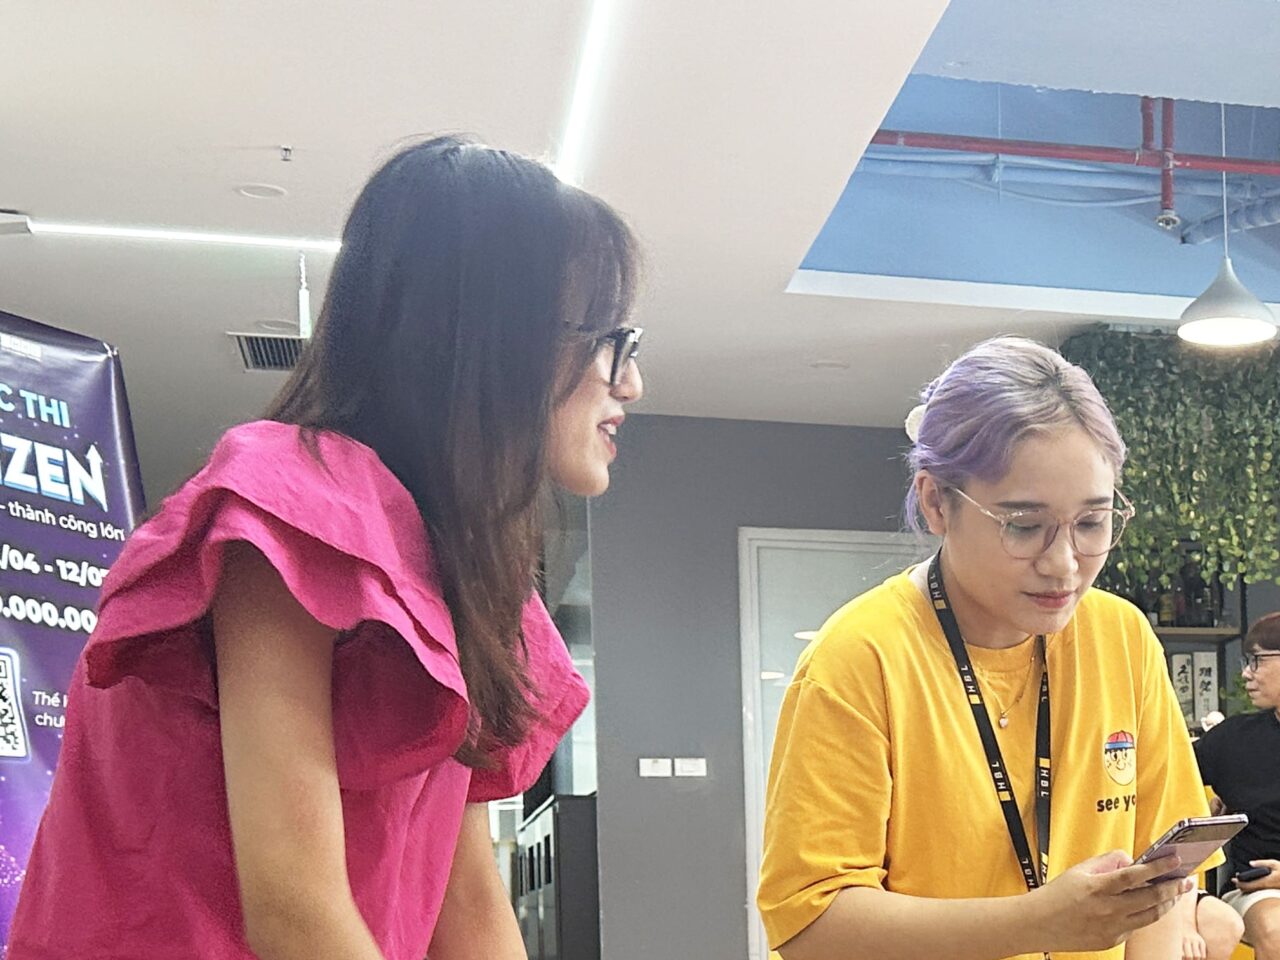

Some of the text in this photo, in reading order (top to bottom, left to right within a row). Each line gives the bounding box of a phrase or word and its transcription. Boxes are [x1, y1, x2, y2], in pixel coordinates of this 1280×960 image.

[19, 388, 71, 429] THI
[0, 431, 109, 513] ZEN
[8, 501, 56, 526] thành
[59, 514, 98, 539] công
[0, 543, 41, 575] /04
[0, 594, 99, 635] .000.00
[960, 664, 977, 693] HBL
[991, 760, 1007, 791] HBL
[1040, 768, 1051, 798] HBL
[1096, 795, 1120, 812] see
